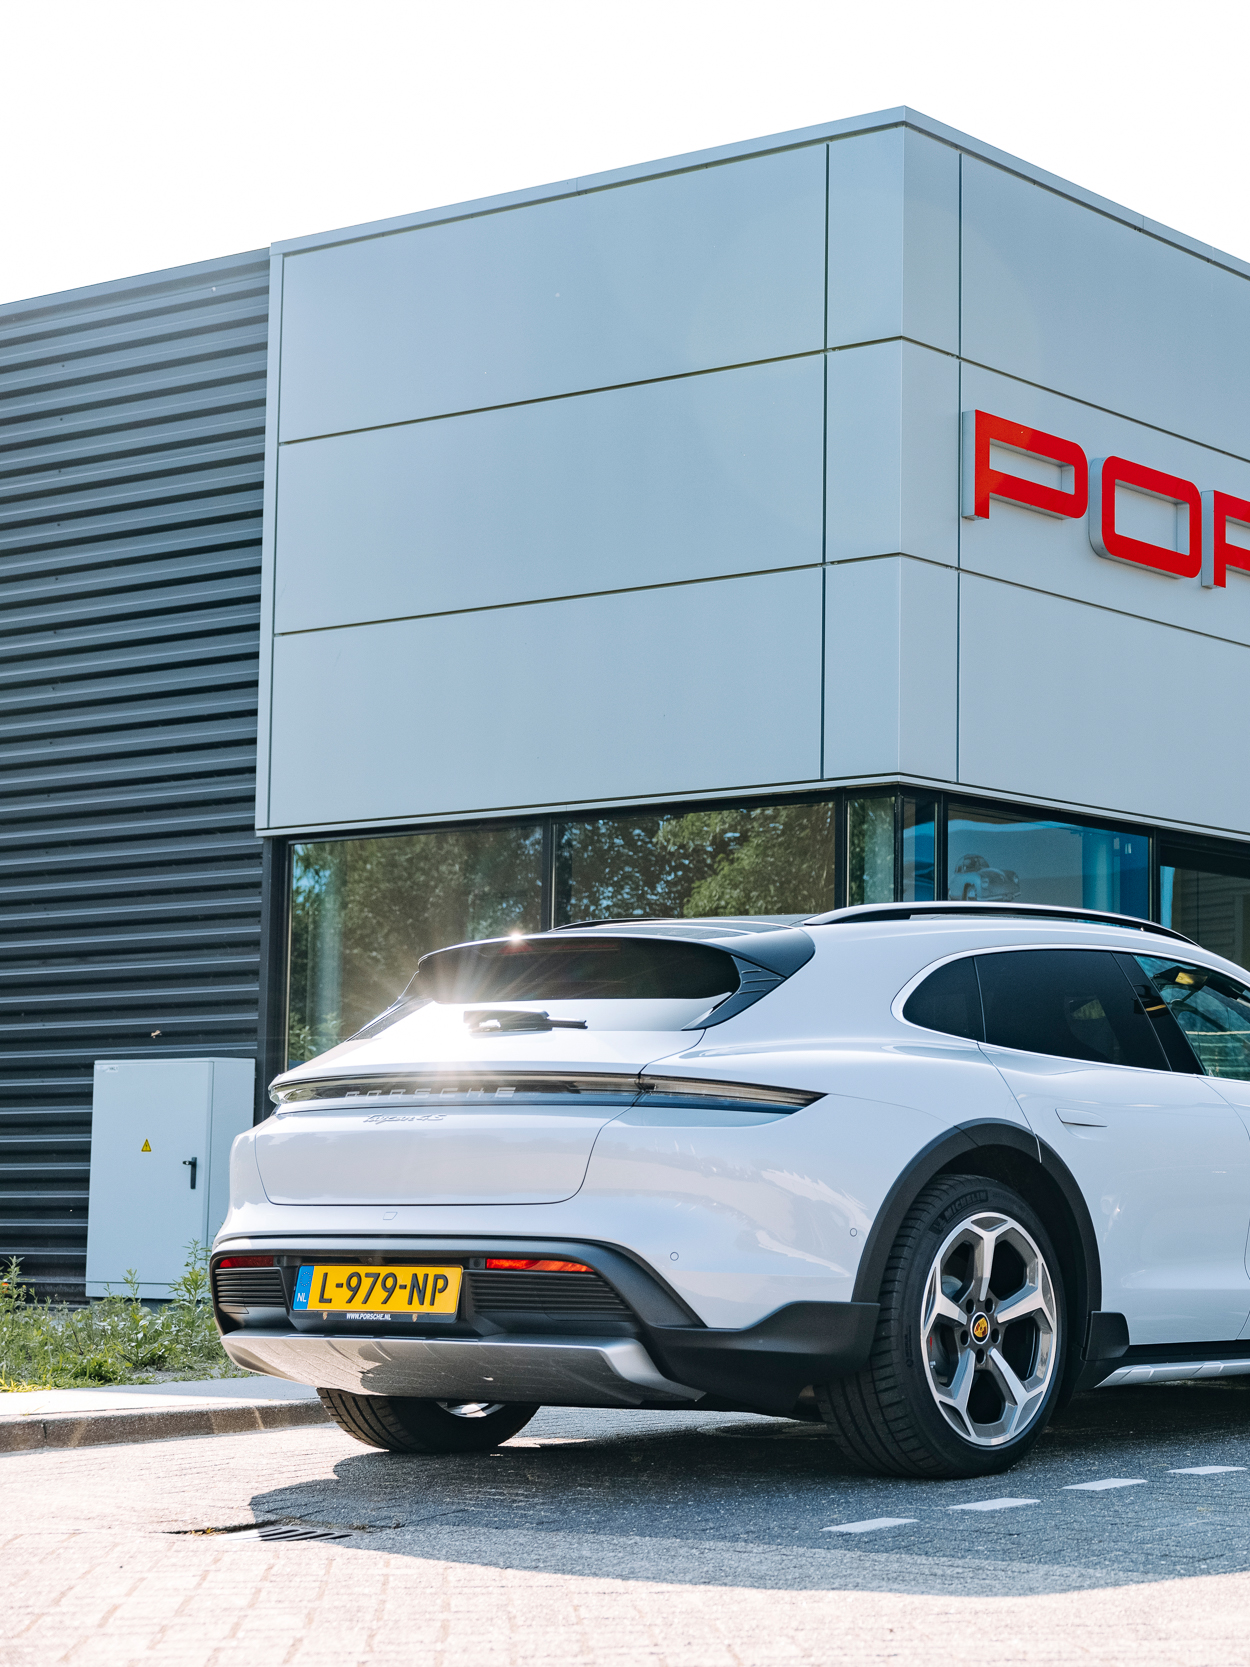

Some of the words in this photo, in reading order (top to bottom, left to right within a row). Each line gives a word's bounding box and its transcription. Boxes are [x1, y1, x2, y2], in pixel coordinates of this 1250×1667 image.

[344, 1087, 516, 1100] PORSCHE
[943, 1189, 988, 1220] MICHELIN
[318, 1271, 449, 1307] L-979-NP
[297, 1292, 307, 1303] NL
[346, 1313, 391, 1321] WWW.PORSCHE.NL
